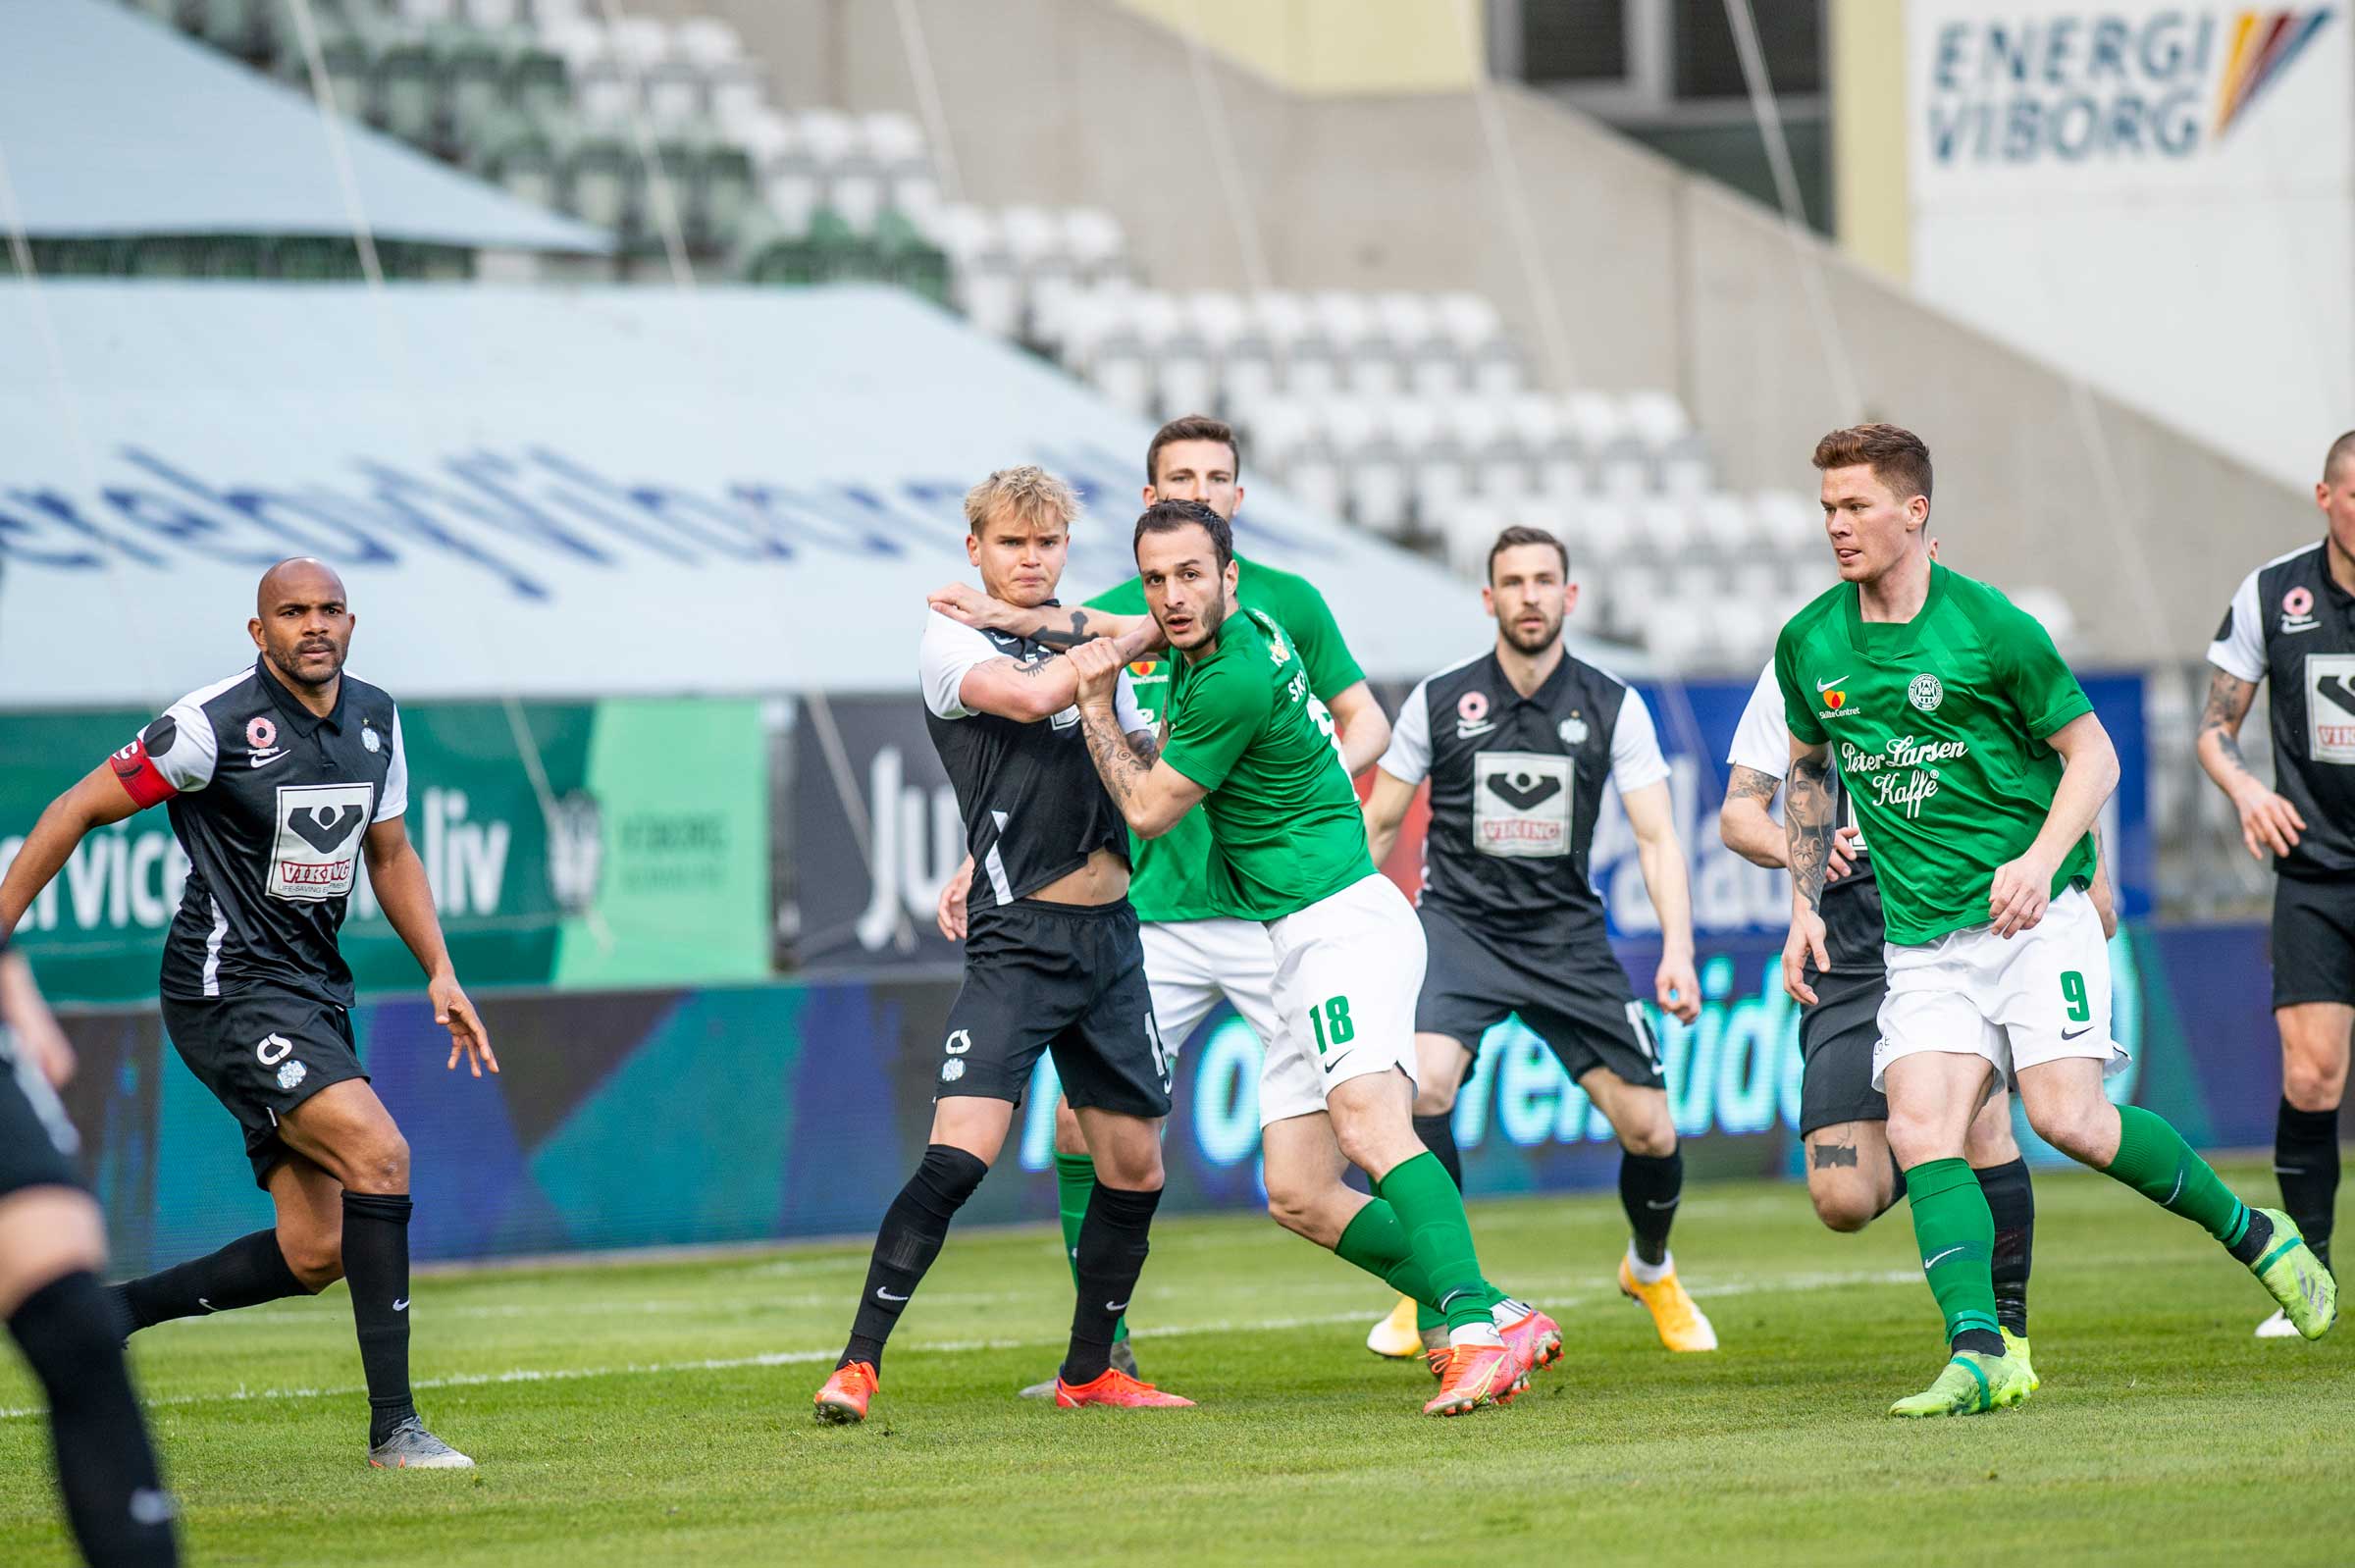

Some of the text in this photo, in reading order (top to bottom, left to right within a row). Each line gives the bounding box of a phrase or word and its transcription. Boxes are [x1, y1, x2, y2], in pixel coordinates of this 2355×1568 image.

[1934, 12, 2216, 89] ENERGI
[1927, 90, 2205, 162] VIBORG
[1842, 735, 1969, 773] Peter Larsen
[281, 859, 351, 884] VIKING
[1309, 995, 1355, 1056] 18
[2060, 970, 2091, 1022] 9
[1144, 1012, 1168, 1076] 1
